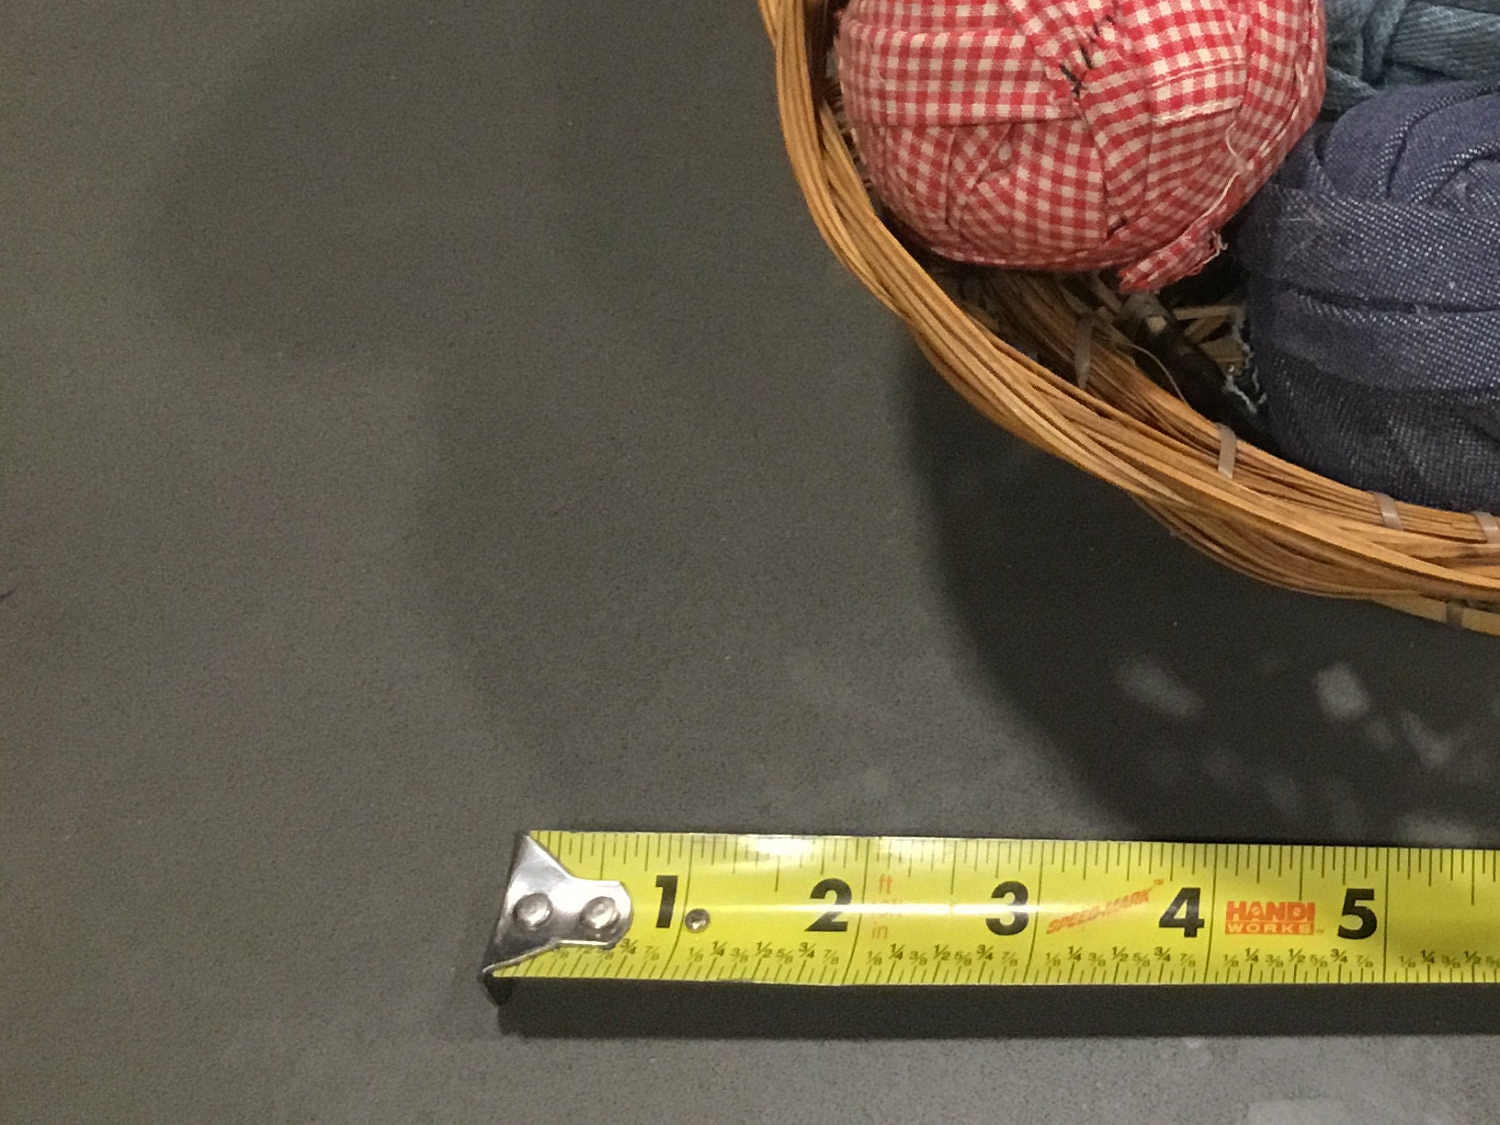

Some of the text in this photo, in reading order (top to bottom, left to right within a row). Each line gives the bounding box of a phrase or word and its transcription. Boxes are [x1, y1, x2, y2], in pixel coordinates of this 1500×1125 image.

[654, 875, 679, 928] 1
[805, 878, 853, 932] 2
[985, 881, 1030, 936] 3
[1158, 887, 1205, 938] 4
[1337, 888, 1378, 940] 5
[1225, 901, 1315, 922] HANDI
[1227, 923, 1311, 933] WORKS
